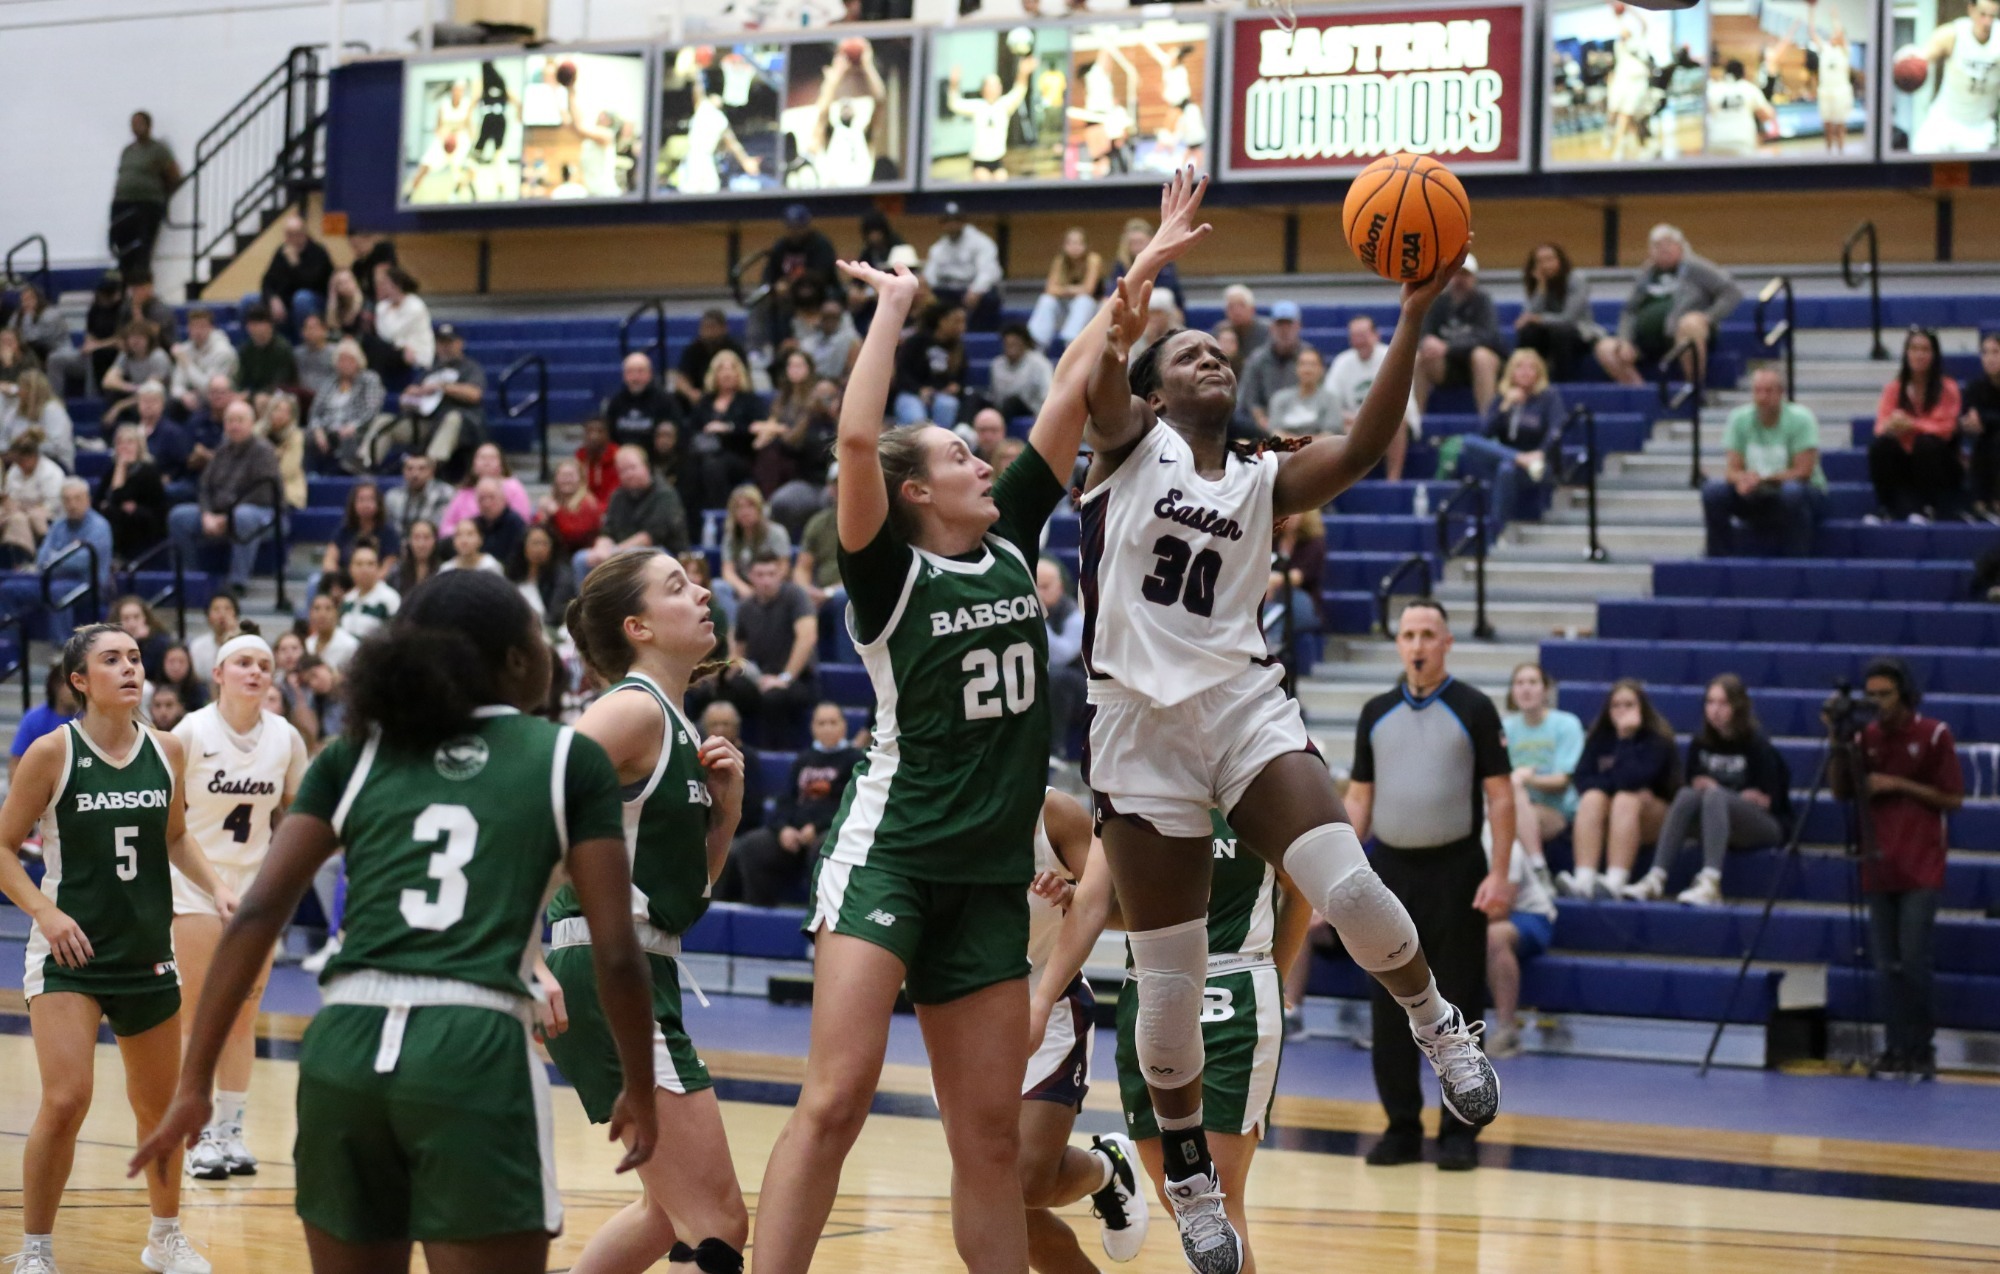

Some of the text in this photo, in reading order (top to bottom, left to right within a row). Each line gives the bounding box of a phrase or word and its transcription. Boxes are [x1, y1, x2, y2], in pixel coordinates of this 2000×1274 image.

[1259, 19, 1491, 76] EASTERN
[1245, 69, 1502, 159] WARRIORS
[1401, 231, 1421, 279] NCAA
[1141, 534, 1223, 618] 30
[930, 594, 1041, 637] BABSON
[962, 642, 1036, 721] 20
[75, 789, 167, 812] BABSON
[207, 769, 276, 795] Eastern
[223, 803, 254, 843] 4
[114, 826, 139, 881] 5
[399, 803, 479, 932] 3
[1200, 986, 1236, 1023] B
